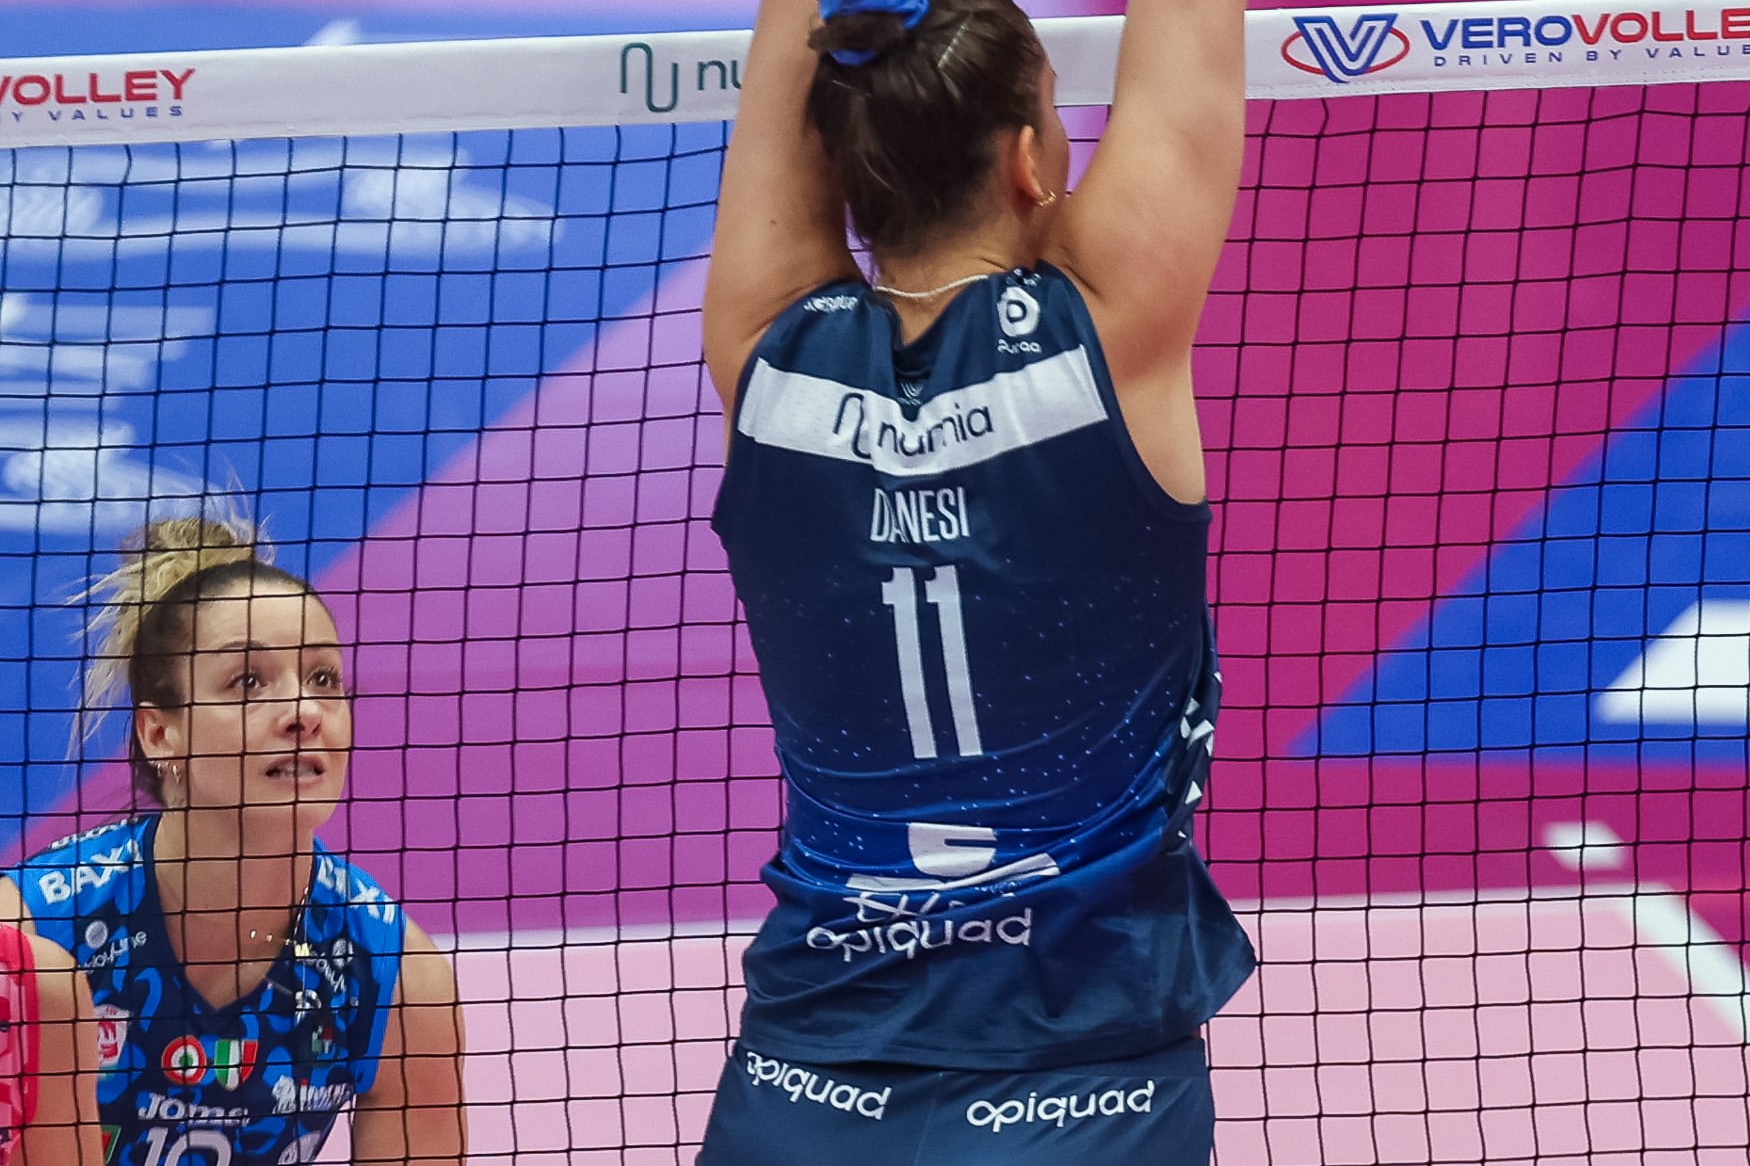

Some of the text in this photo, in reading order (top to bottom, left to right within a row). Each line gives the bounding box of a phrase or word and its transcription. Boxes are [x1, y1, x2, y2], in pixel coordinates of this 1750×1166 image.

[1433, 52, 1564, 67] DRIVEN
[1587, 48, 1623, 63] BY
[48, 105, 184, 121] VALUES
[877, 401, 993, 458] numia
[870, 485, 969, 545] DANESI
[881, 564, 984, 759] 11
[806, 907, 1032, 963] opiquad
[746, 1050, 893, 1121] opiquad
[965, 1079, 1155, 1133] opiquad
